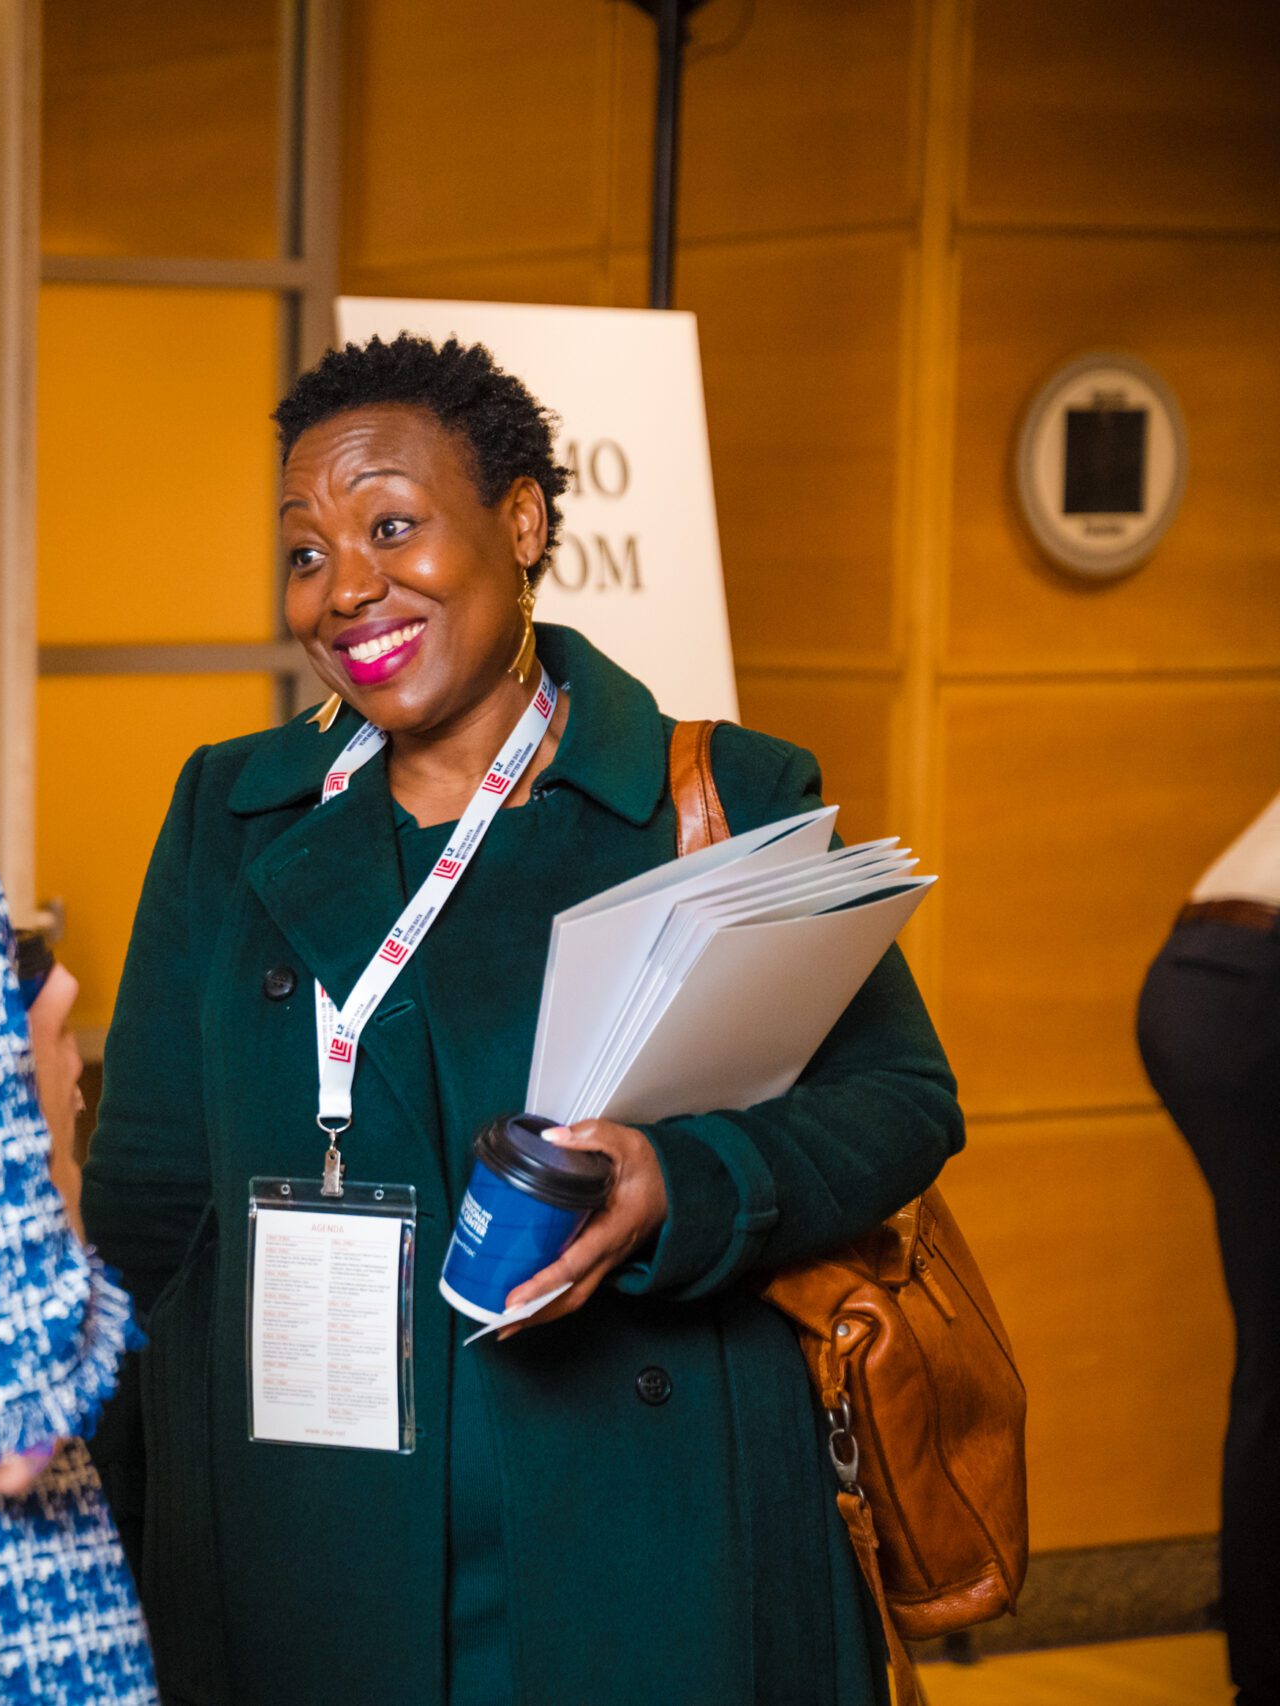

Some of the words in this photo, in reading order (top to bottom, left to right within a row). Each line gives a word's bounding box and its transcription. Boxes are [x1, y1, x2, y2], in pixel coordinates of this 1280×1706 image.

[493, 761, 504, 772] L2
[444, 847, 455, 857] L2
[392, 927, 404, 938] L2
[336, 1023, 345, 1035] L2
[311, 1223, 344, 1233] AGENDA
